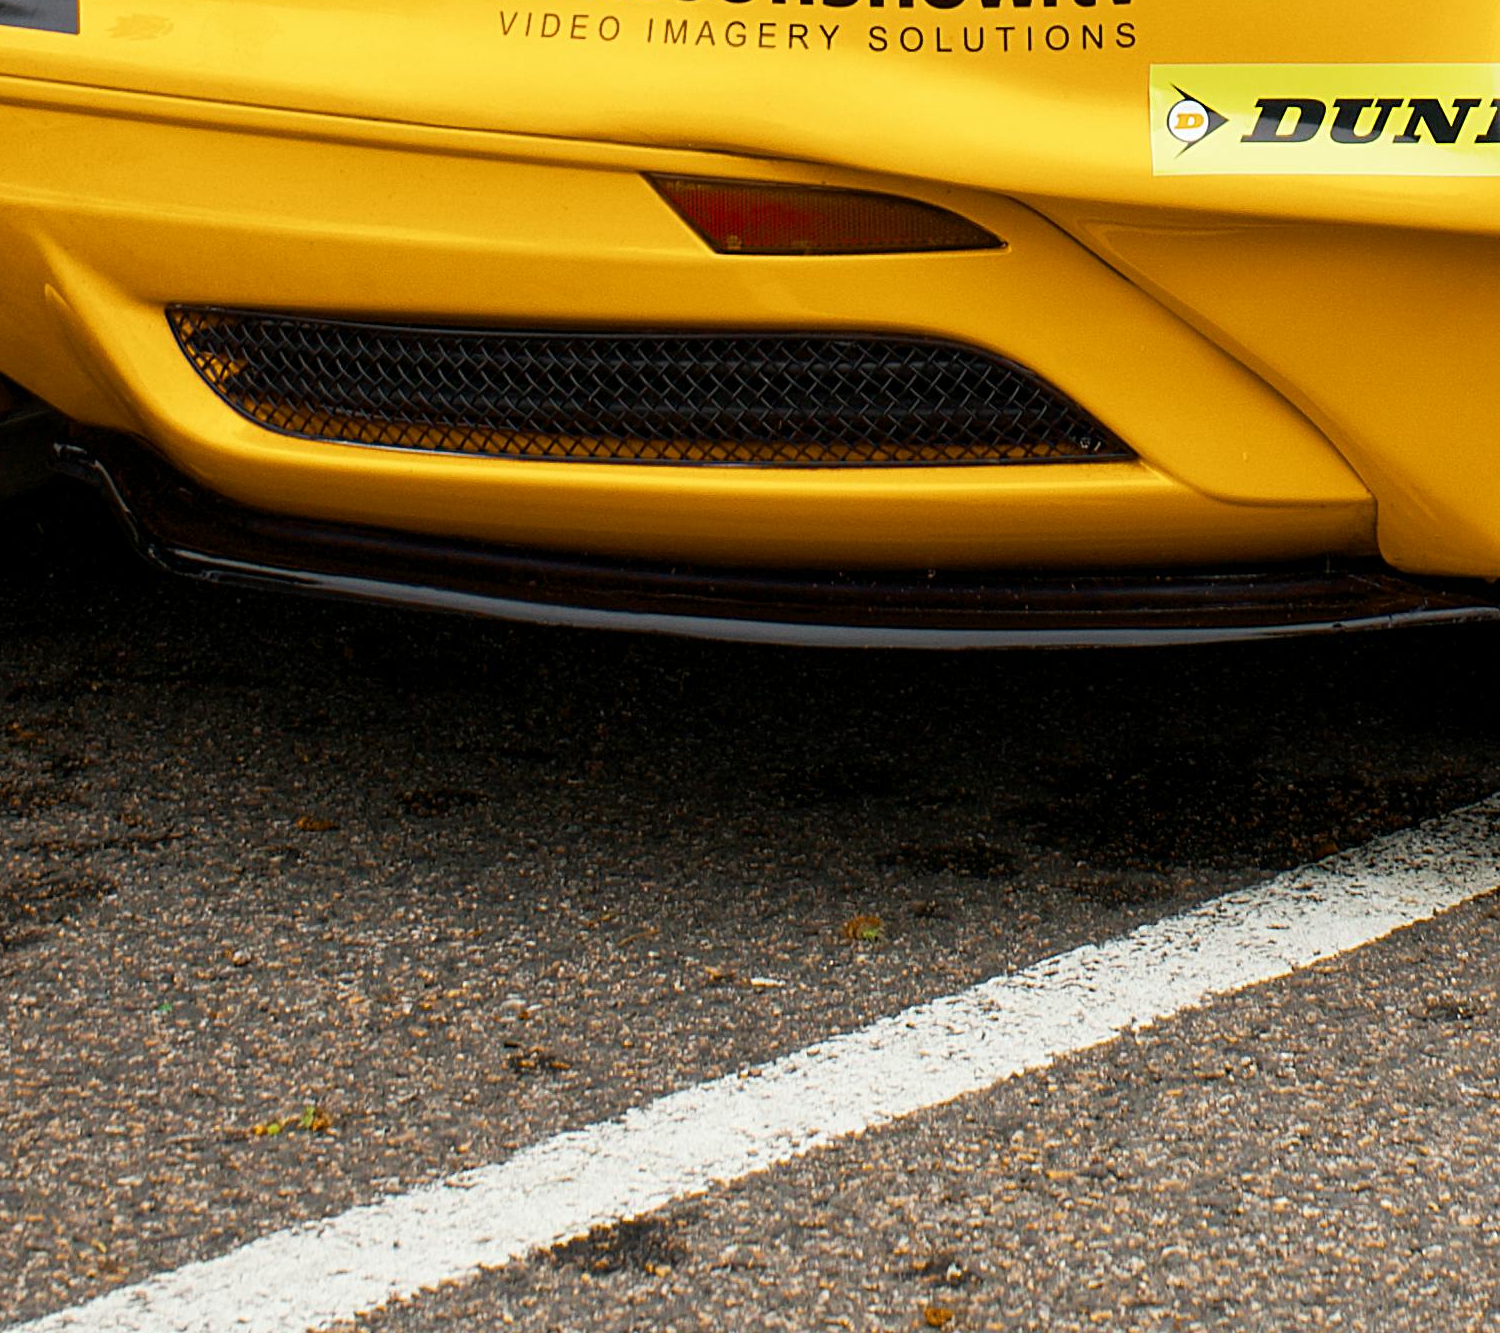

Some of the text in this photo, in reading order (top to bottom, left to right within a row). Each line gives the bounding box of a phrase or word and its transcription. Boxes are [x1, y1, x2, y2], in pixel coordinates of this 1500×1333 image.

[498, 10, 1138, 53] VIDEO IMAGERY SOLUTIONS
